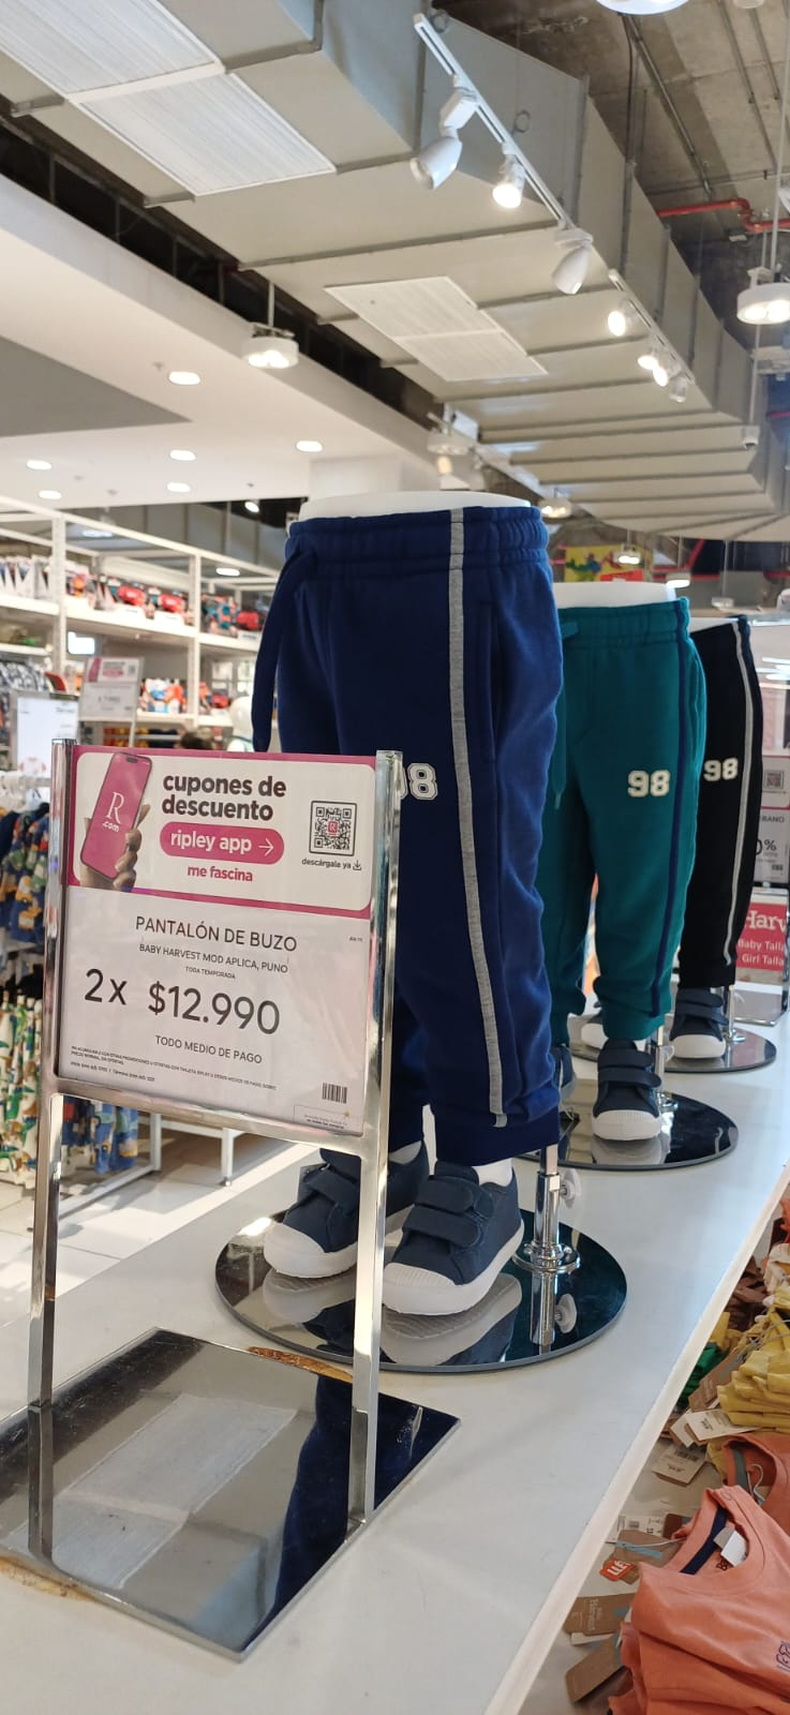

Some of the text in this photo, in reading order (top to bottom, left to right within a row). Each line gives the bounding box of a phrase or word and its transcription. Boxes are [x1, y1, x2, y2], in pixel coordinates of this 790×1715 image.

[627, 769, 671, 798] 98
[703, 757, 739, 782] 98
[163, 775, 287, 798] cupones de
[105, 791, 123, 825] R
[161, 794, 274, 821] descuento
[170, 830, 253, 855] ripley app
[187, 865, 254, 882] me fascina
[135, 916, 298, 952] PANTALÓN DE BUZO
[139, 943, 289, 974] BABY HARVEST MOD APLICA, PUNO
[148, 980, 281, 1035] $12.990
[155, 1034, 263, 1065] TODO MEDIO DE PAGO
